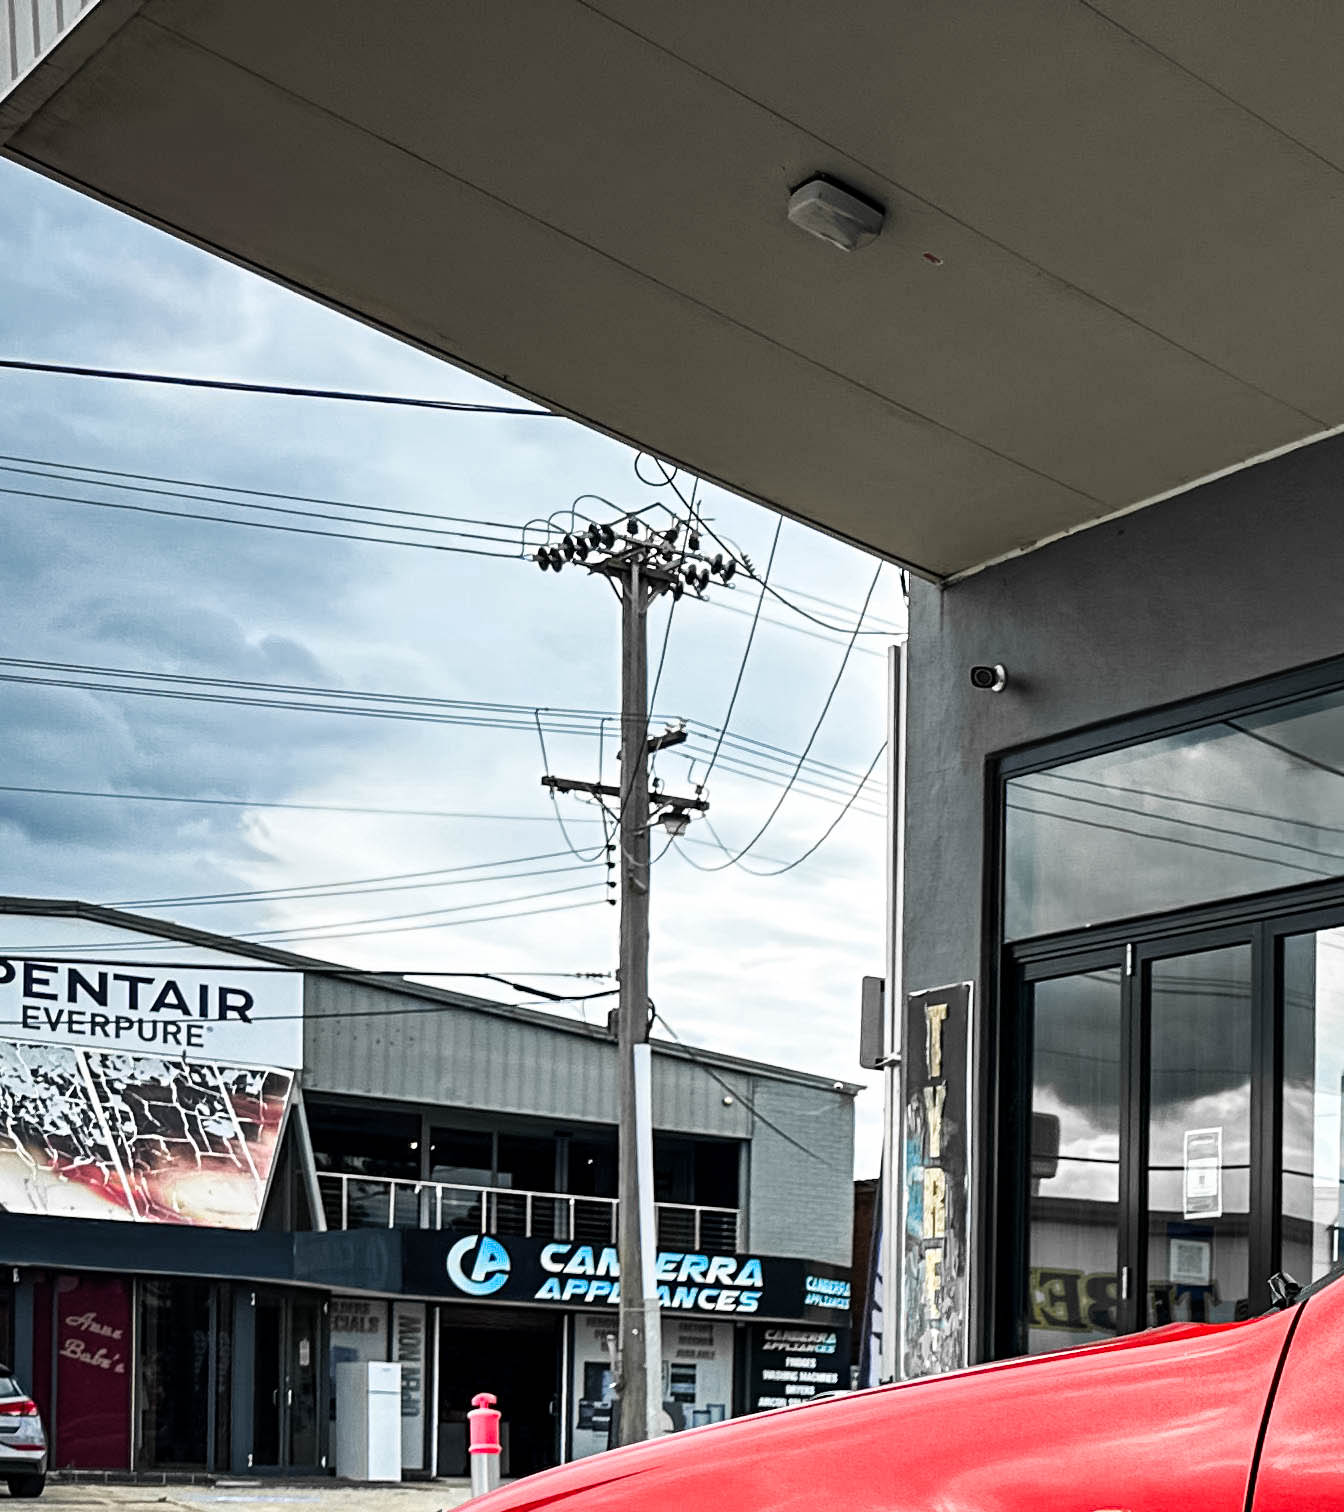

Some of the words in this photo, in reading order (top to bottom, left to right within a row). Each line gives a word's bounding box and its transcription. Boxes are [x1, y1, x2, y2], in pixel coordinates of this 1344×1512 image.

[22, 1005, 205, 1047] EVERPURE
[540, 1243, 764, 1287] CANERRA
[534, 1277, 764, 1313] APPLANCES
